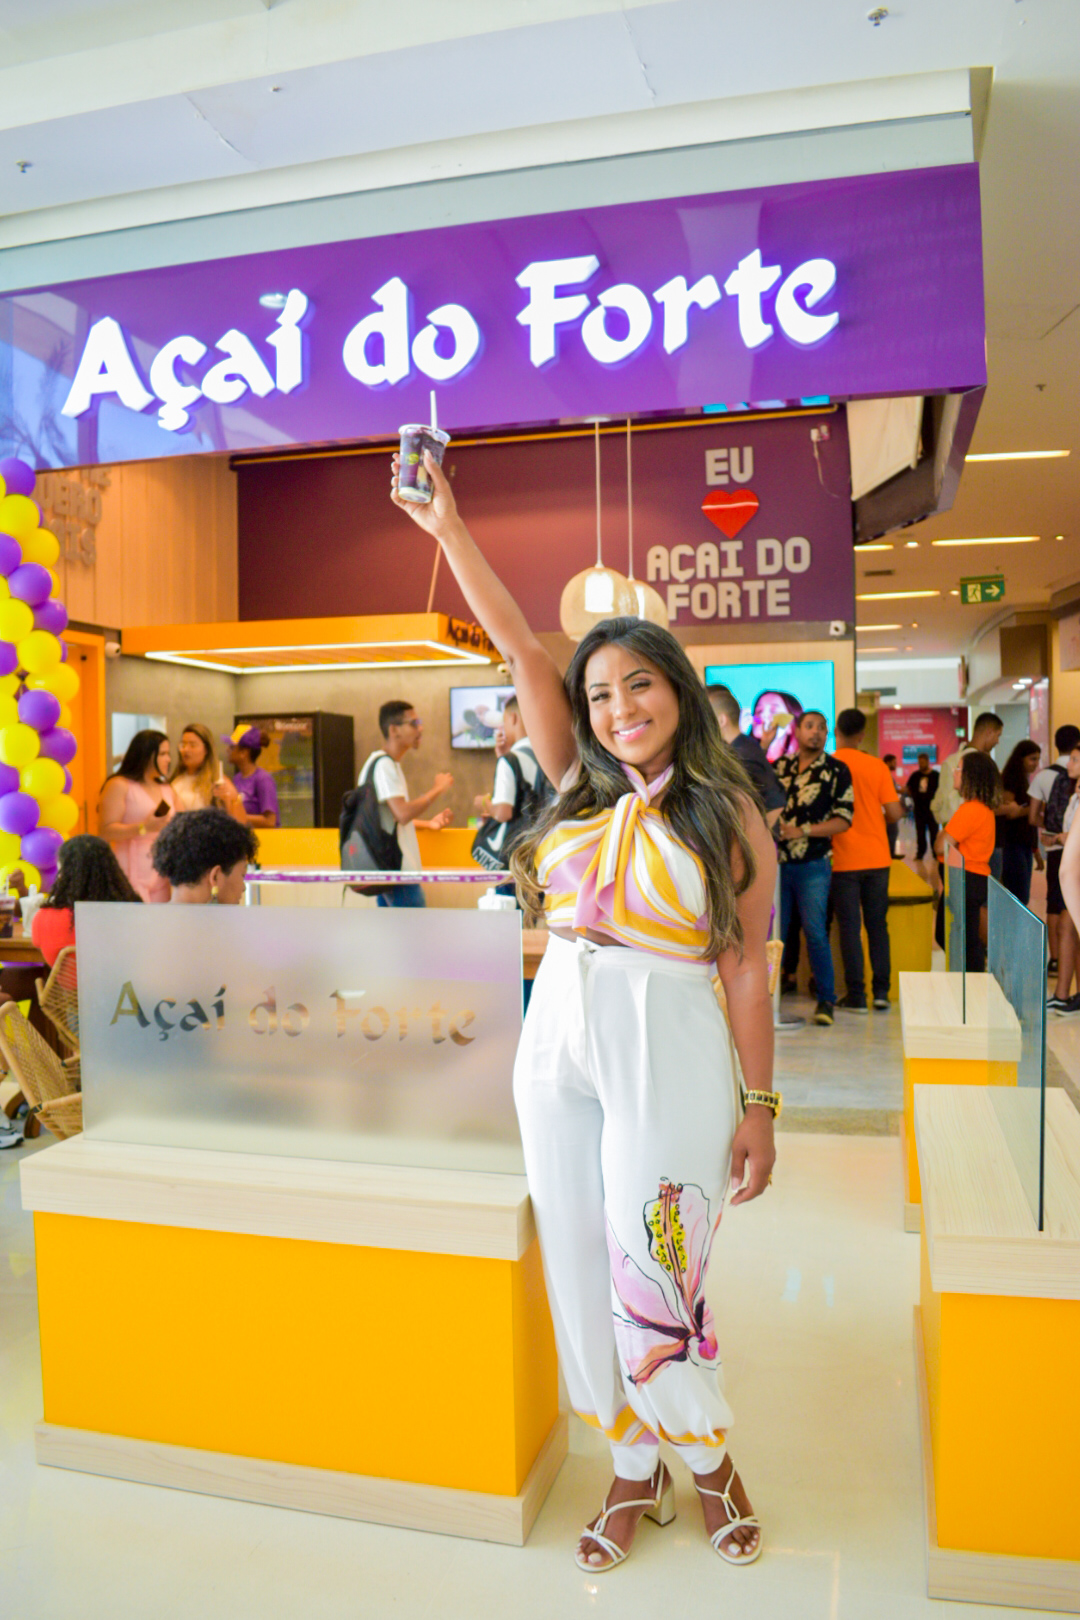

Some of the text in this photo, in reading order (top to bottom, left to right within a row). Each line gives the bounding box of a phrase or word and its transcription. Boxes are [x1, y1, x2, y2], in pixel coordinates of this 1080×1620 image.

[61, 248, 839, 431] Açaí do Forte
[704, 446, 754, 486] EU
[646, 536, 811, 583] AÇAI DO
[667, 579, 791, 621] FORTE
[109, 980, 477, 1046] Açaí do Forte
